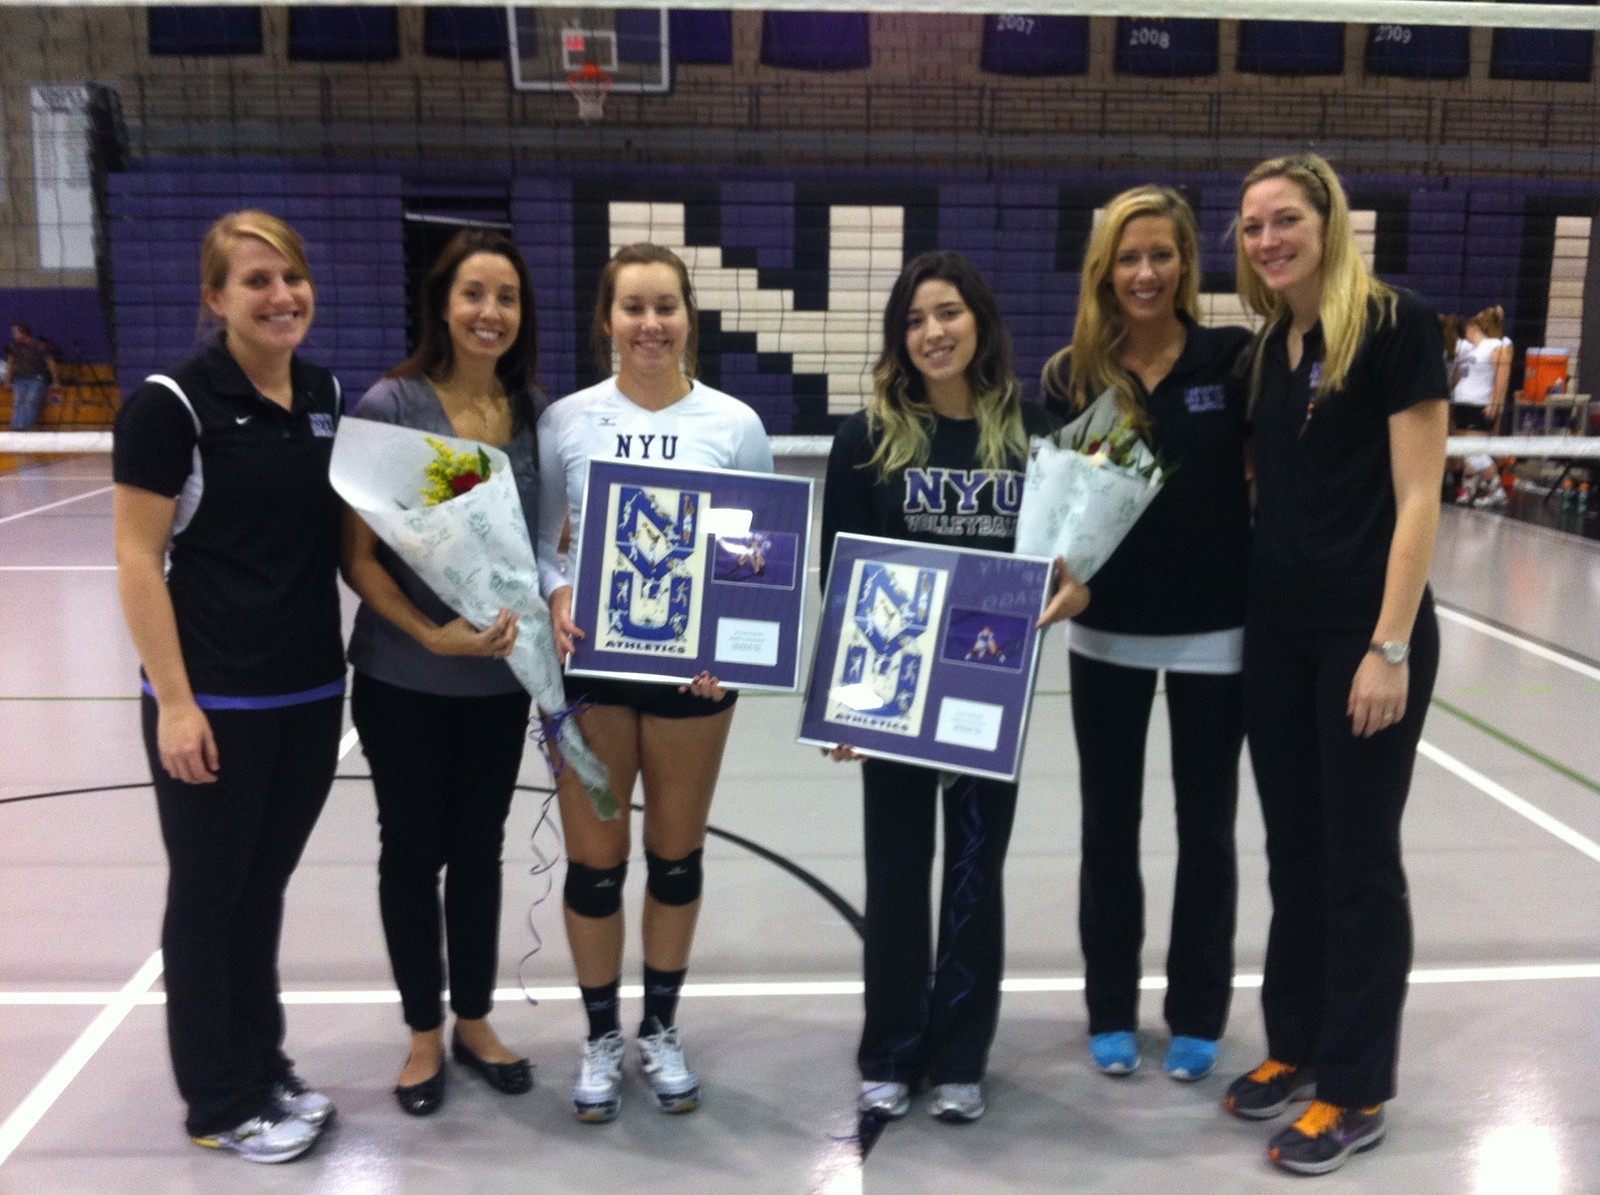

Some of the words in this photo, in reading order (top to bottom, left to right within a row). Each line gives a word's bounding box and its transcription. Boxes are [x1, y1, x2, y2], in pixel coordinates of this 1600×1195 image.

[1129, 27, 1170, 49] 2008
[615, 433, 679, 460] NYU
[903, 467, 1026, 515] NYU
[605, 640, 686, 654] ATHLETICS
